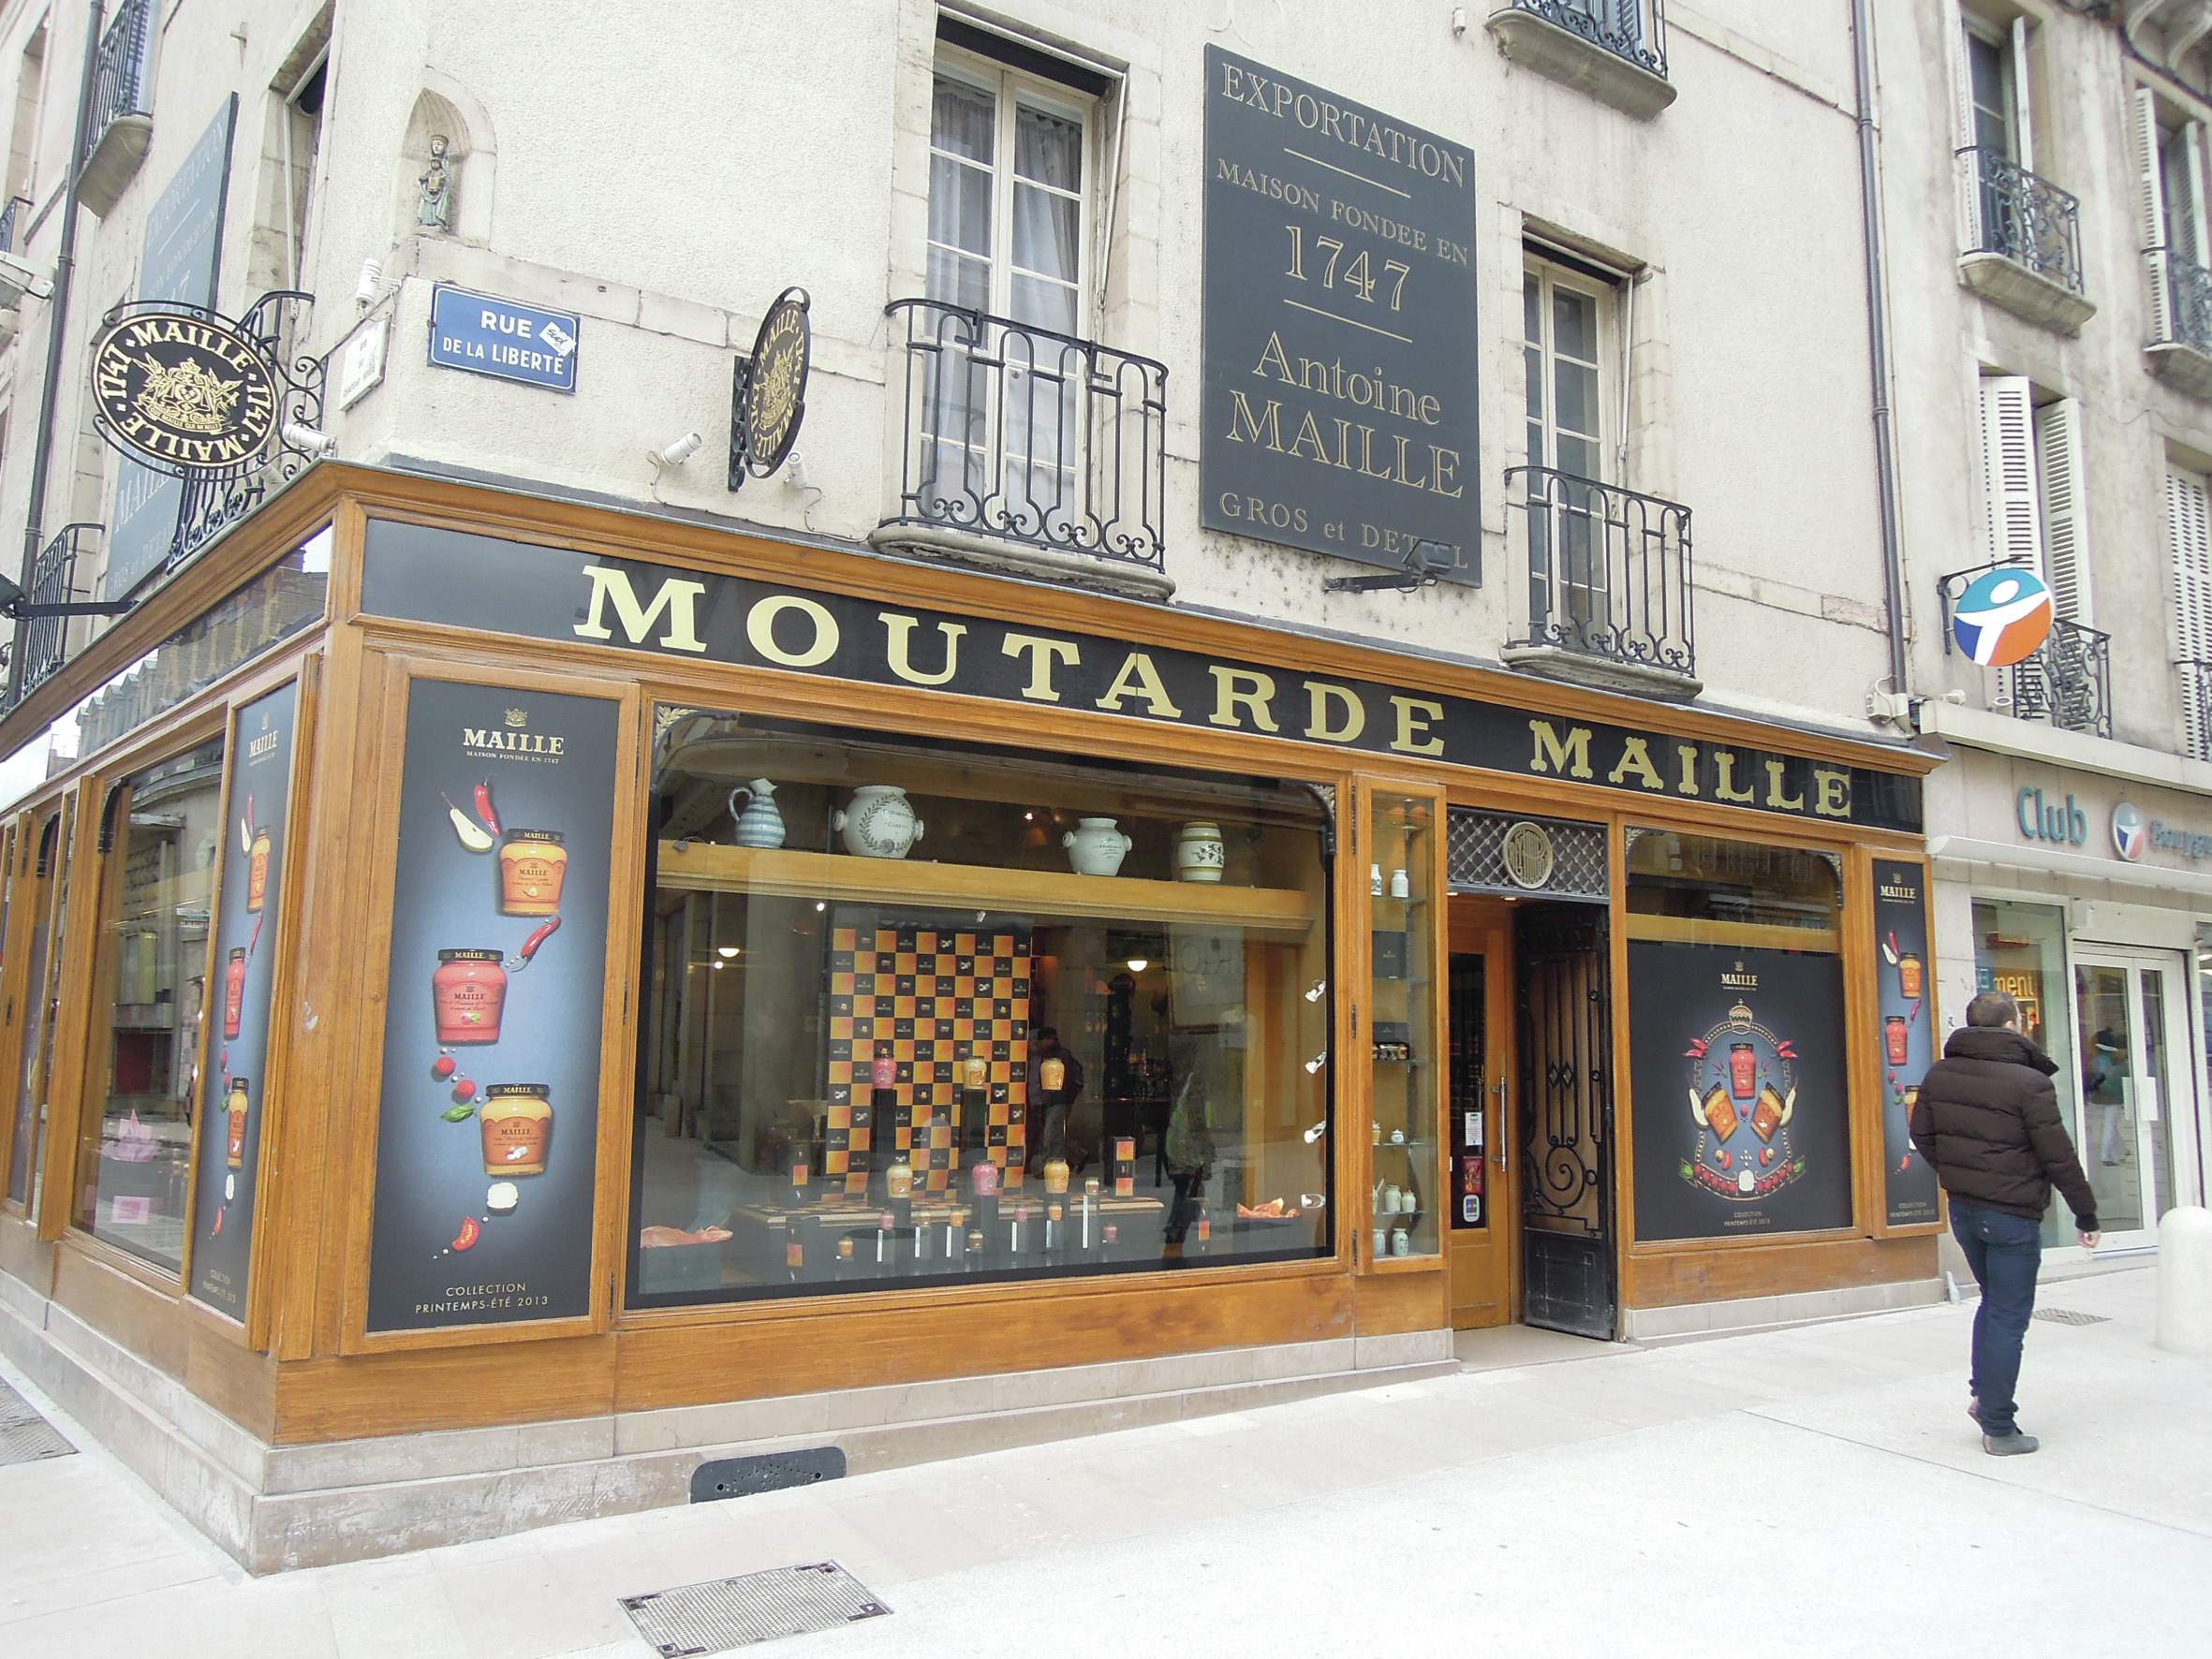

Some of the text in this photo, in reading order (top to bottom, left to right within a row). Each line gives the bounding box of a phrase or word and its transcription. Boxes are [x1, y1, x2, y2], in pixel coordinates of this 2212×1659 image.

[1220, 62, 1465, 188] EXPORTATION
[1217, 157, 1468, 266] MAISON FONDEE EN
[1285, 225, 1411, 312] 1747
[129, 321, 255, 373] MAILLE
[443, 337, 462, 354] DE
[466, 342, 484, 359] LA
[480, 310, 532, 339] RUE
[100, 344, 133, 399] 1747
[1251, 330, 1441, 427] Antoine
[120, 412, 246, 462] MAILLE
[242, 385, 273, 438] 1747
[1226, 389, 1463, 499] MAILLE
[1219, 492, 1468, 569] GROS et DETL
[573, 565, 1851, 819] MOUTARDE MAILLE
[463, 728, 565, 756] MAILLE
[466, 750, 497, 759] MAISON
[2016, 786, 2087, 846] Club
[1880, 885, 1916, 899] MAILLE
[1721, 973, 1759, 986] MAILLE
[415, 1296, 548, 1314] PRINTEMPS-ÉTÉ 2013
[446, 1283, 525, 1297] COLLECTION
